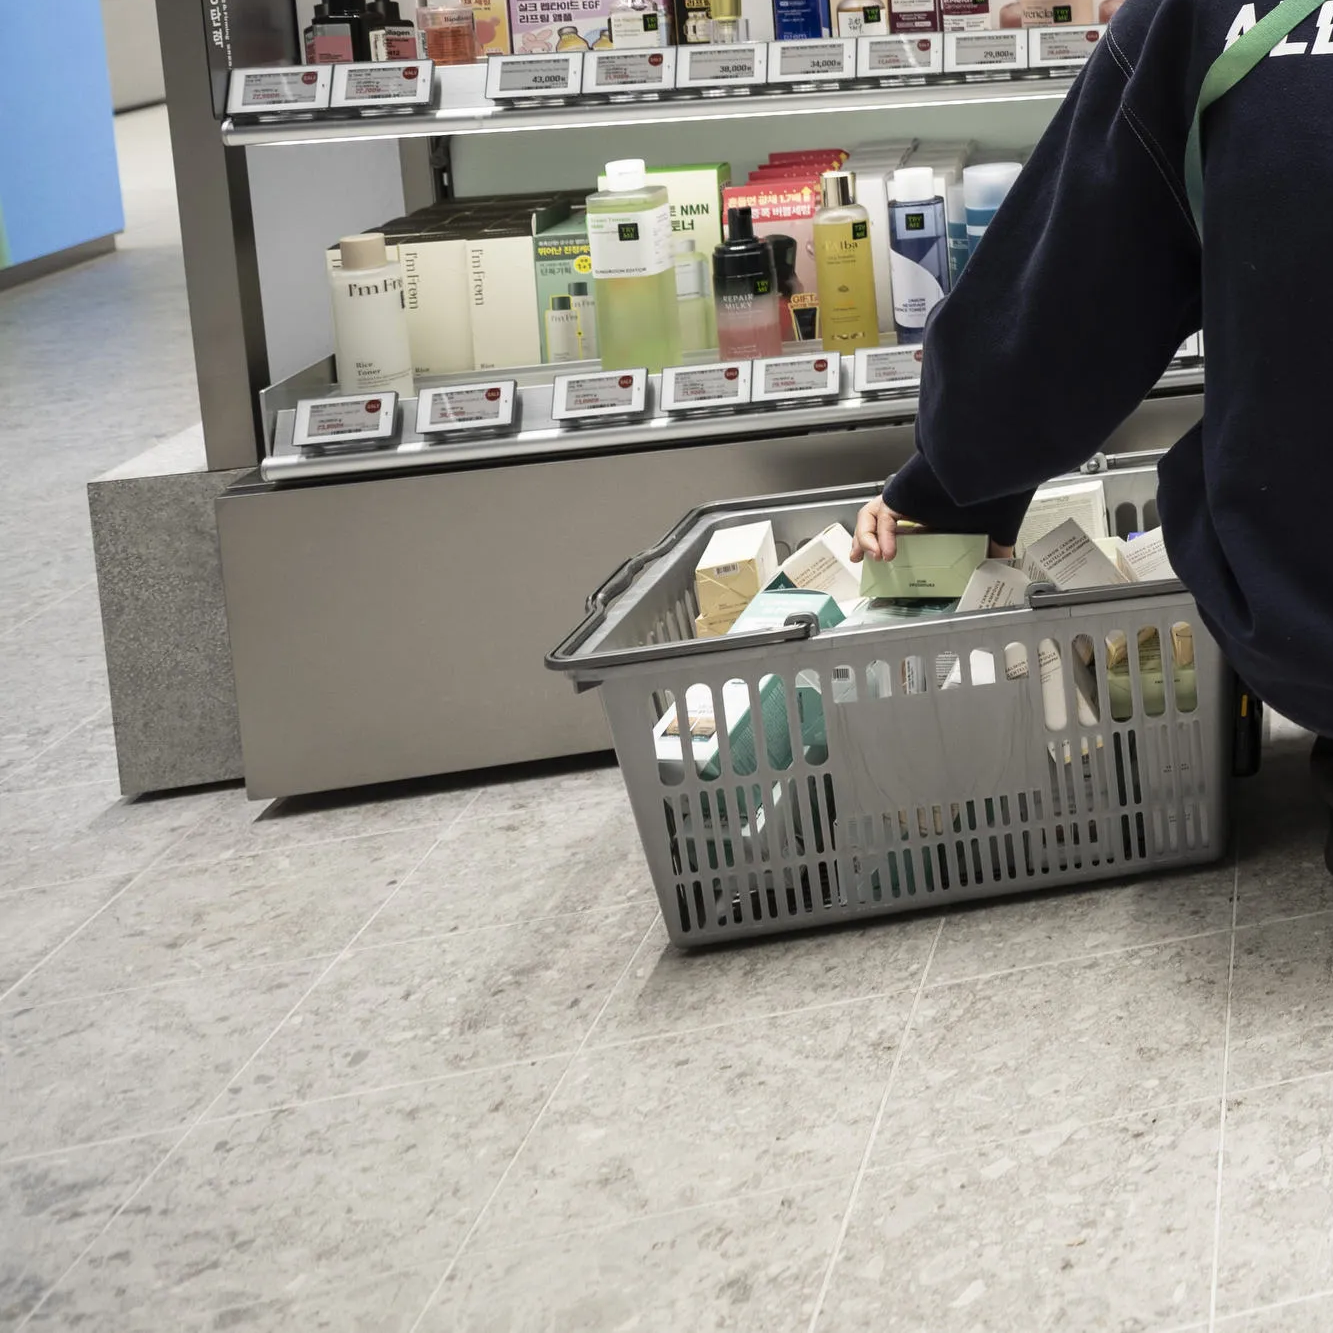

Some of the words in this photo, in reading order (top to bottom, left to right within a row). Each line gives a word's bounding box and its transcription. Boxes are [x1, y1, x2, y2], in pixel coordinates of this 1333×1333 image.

[582, 0, 601, 10] EGF
[518, 13, 550, 24] 리프팅
[680, 202, 710, 216] NMN
[722, 294, 754, 303] REPAIR
[792, 294, 814, 303] GIFT
[725, 301, 752, 309] MILKY
[357, 368, 382, 377] Toner
